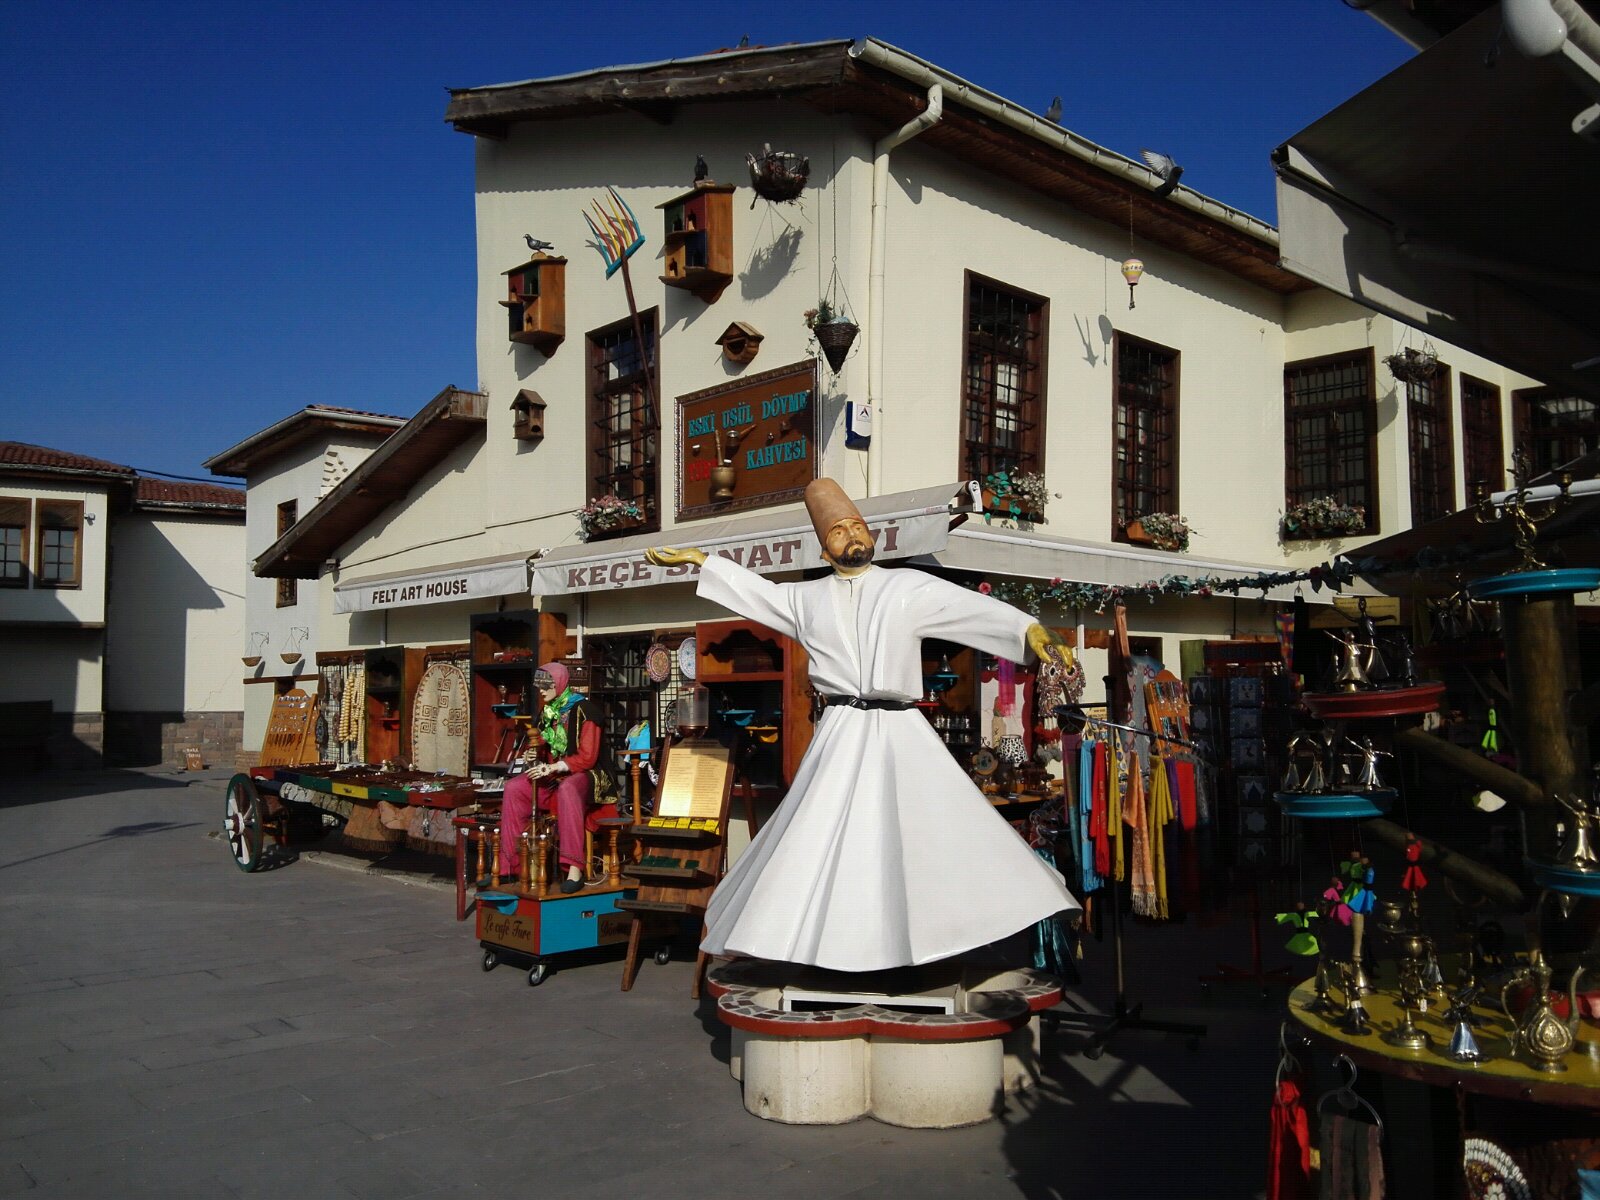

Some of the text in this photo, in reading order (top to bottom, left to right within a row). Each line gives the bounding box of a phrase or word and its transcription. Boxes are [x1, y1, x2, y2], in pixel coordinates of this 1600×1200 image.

[688, 391, 809, 437] ESKİ USÜL DÖVME
[746, 434, 807, 470] KAHVESİ
[567, 560, 651, 588] KEÇE
[372, 579, 467, 604] FELT ART HOUSE
